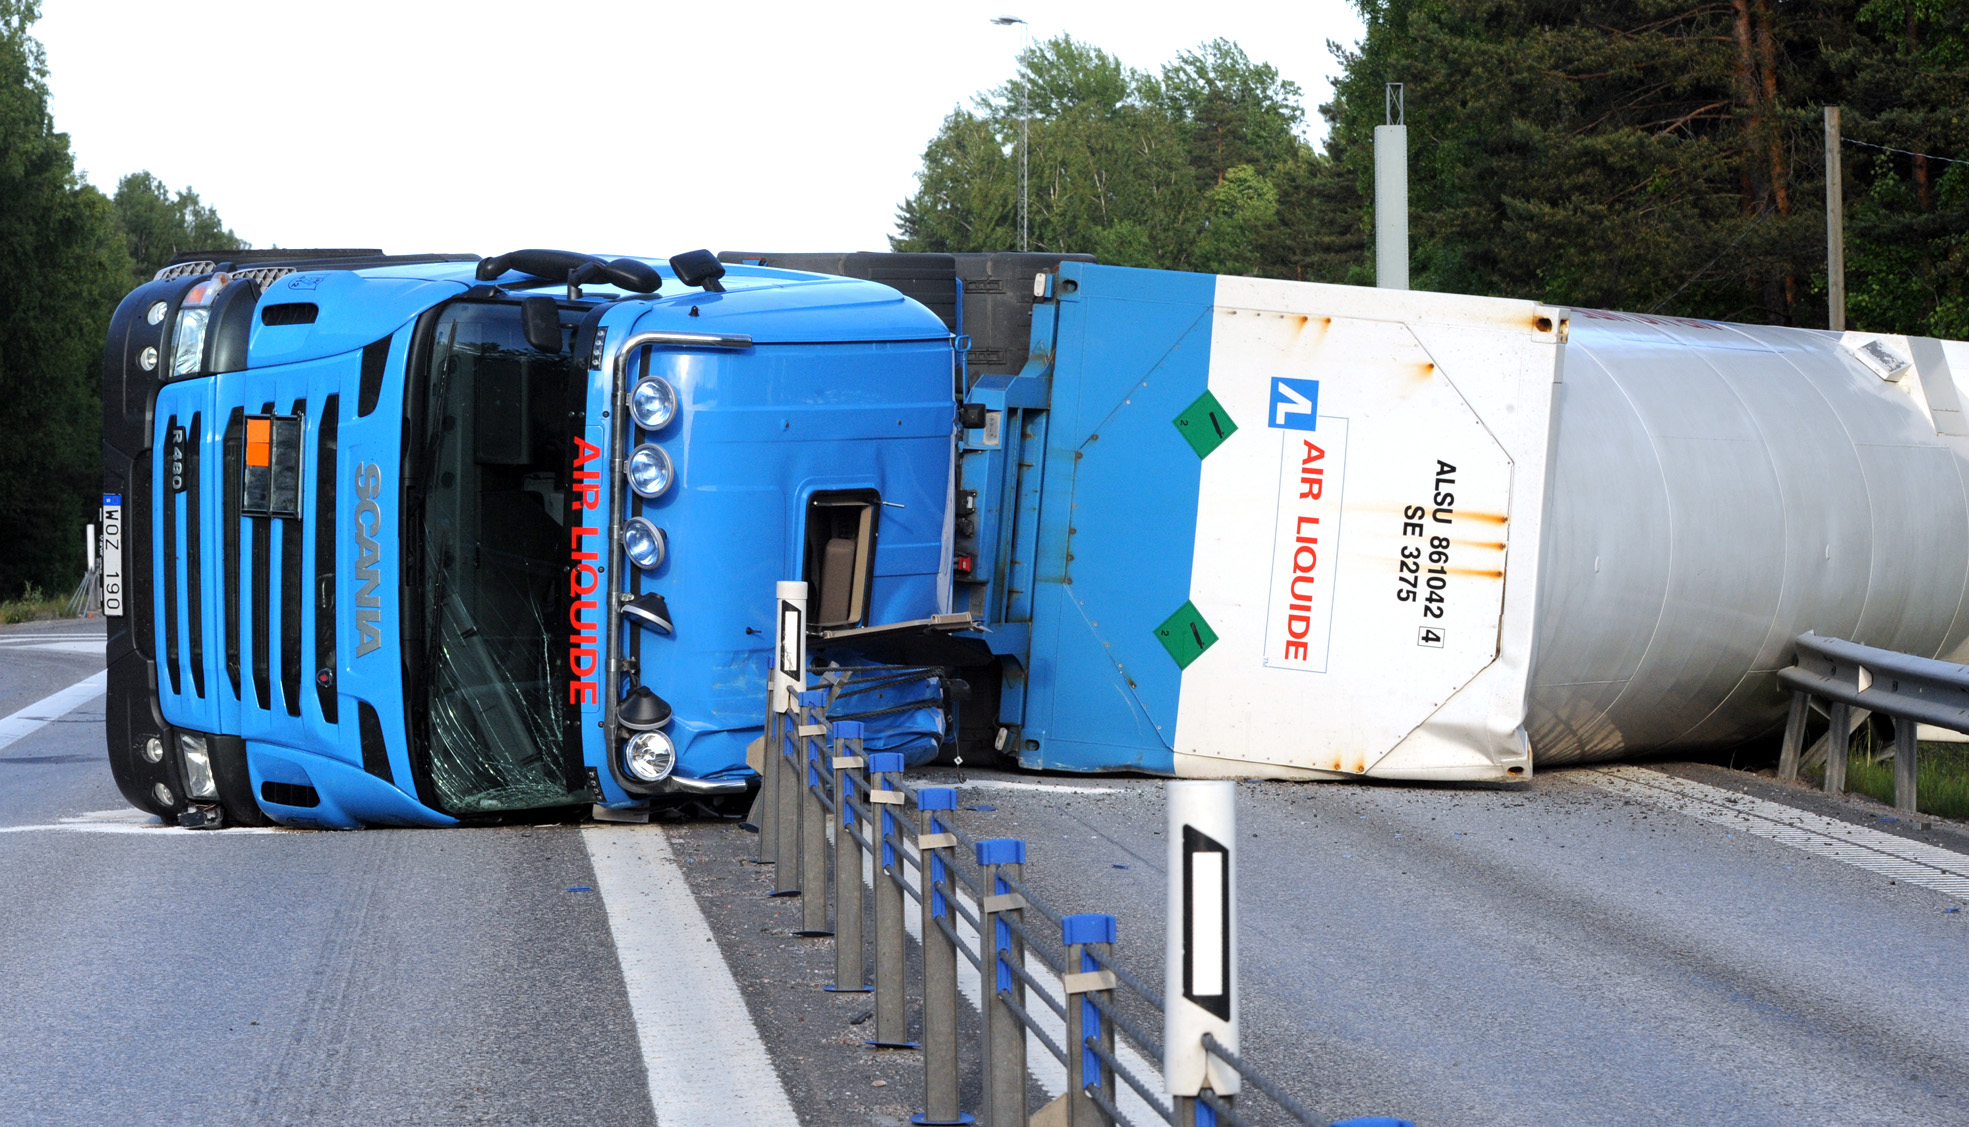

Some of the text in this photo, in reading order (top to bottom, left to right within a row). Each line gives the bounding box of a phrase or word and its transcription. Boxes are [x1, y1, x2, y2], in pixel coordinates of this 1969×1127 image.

[172, 429, 183, 490] R 480
[1179, 419, 1189, 427] 2
[105, 509, 120, 609] WOZ 190
[355, 461, 382, 659] SCANIA
[569, 436, 601, 706] AIR LIQUIDE
[1284, 439, 1325, 661] AIR LIQUIDE
[1396, 505, 1426, 603] SE 3275
[1420, 459, 1457, 643] ALSU 861042 4
[1159, 629, 1170, 638] 2
